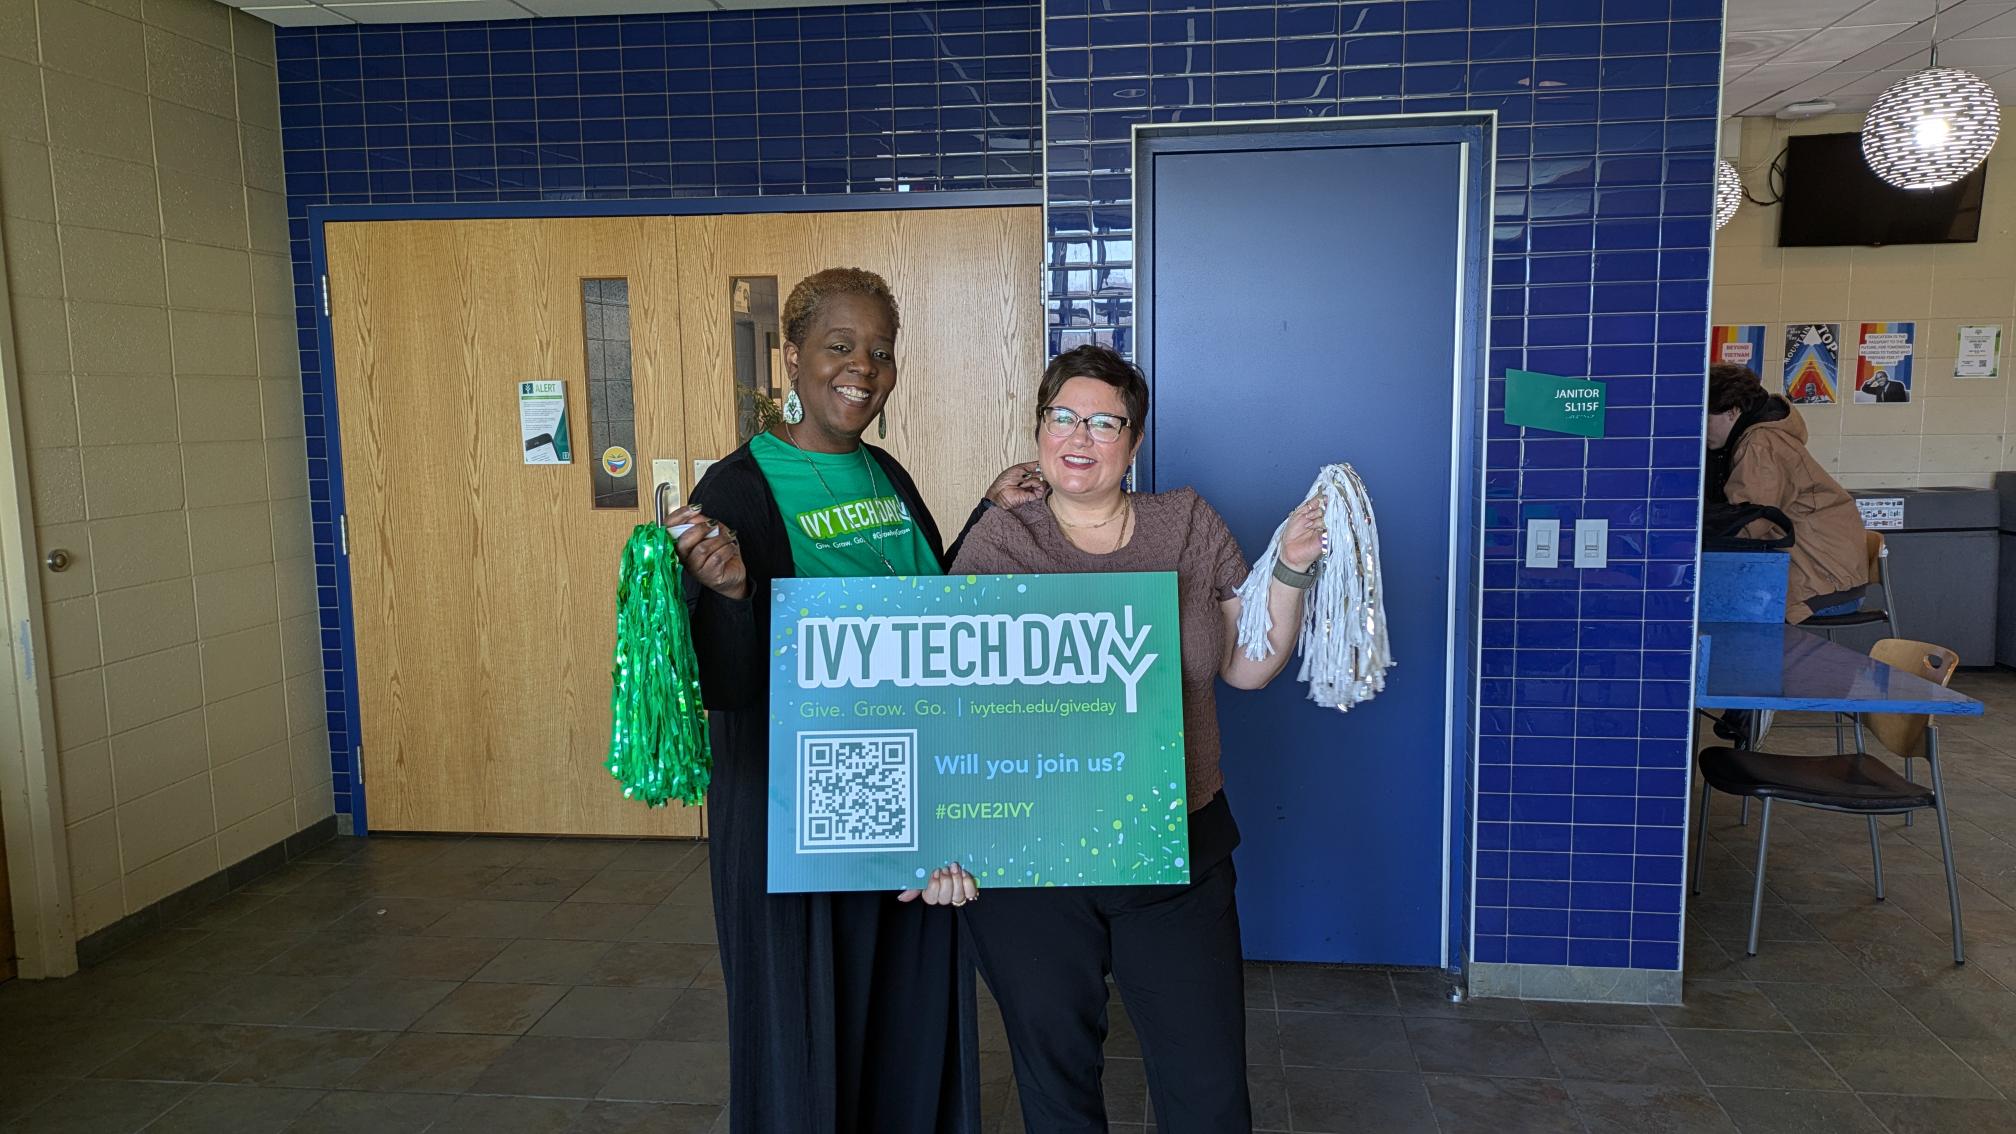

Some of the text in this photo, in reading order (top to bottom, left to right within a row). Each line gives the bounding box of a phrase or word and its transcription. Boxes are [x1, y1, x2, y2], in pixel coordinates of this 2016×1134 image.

[535, 384, 556, 393] ALERT
[1555, 388, 1600, 399] JANITOR
[1564, 401, 1600, 412] SL115F
[800, 498, 902, 538] IVY TECH DAY
[853, 536, 867, 544] Go.
[804, 619, 1109, 682] IVY TECH DAY
[800, 699, 947, 718] Give. Grow. Go.
[970, 697, 1117, 718] ivytech.edu/giveday
[934, 751, 1126, 780] Will you join us?
[935, 801, 1035, 820] #GIVE2IVY
